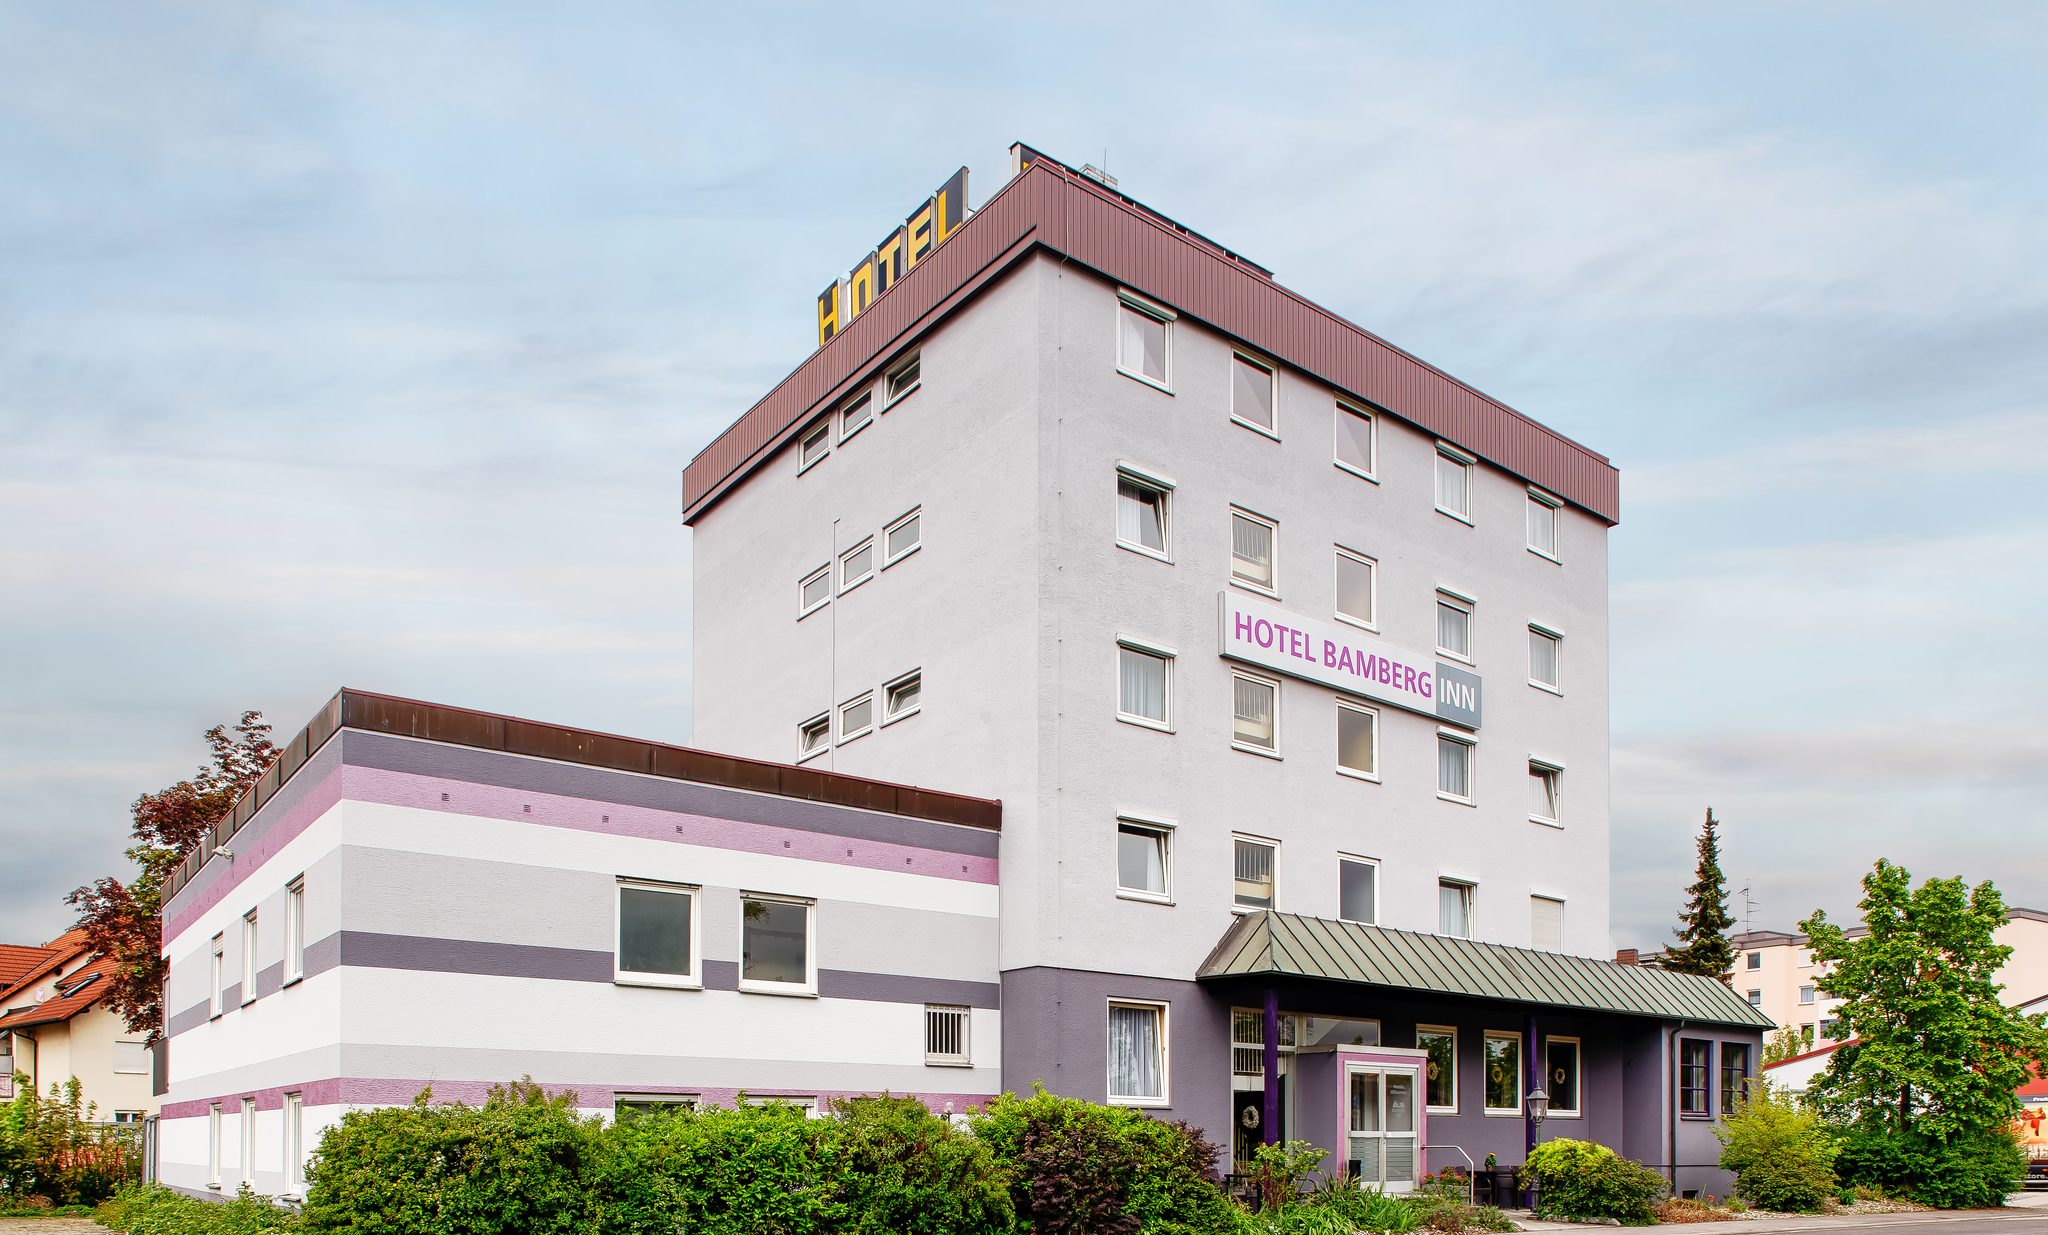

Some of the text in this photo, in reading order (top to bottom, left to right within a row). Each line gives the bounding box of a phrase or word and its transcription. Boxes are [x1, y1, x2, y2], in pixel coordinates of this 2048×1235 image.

[818, 190, 963, 347] HOTEL
[1235, 611, 1476, 713] HOTEL BAMBERG INN
